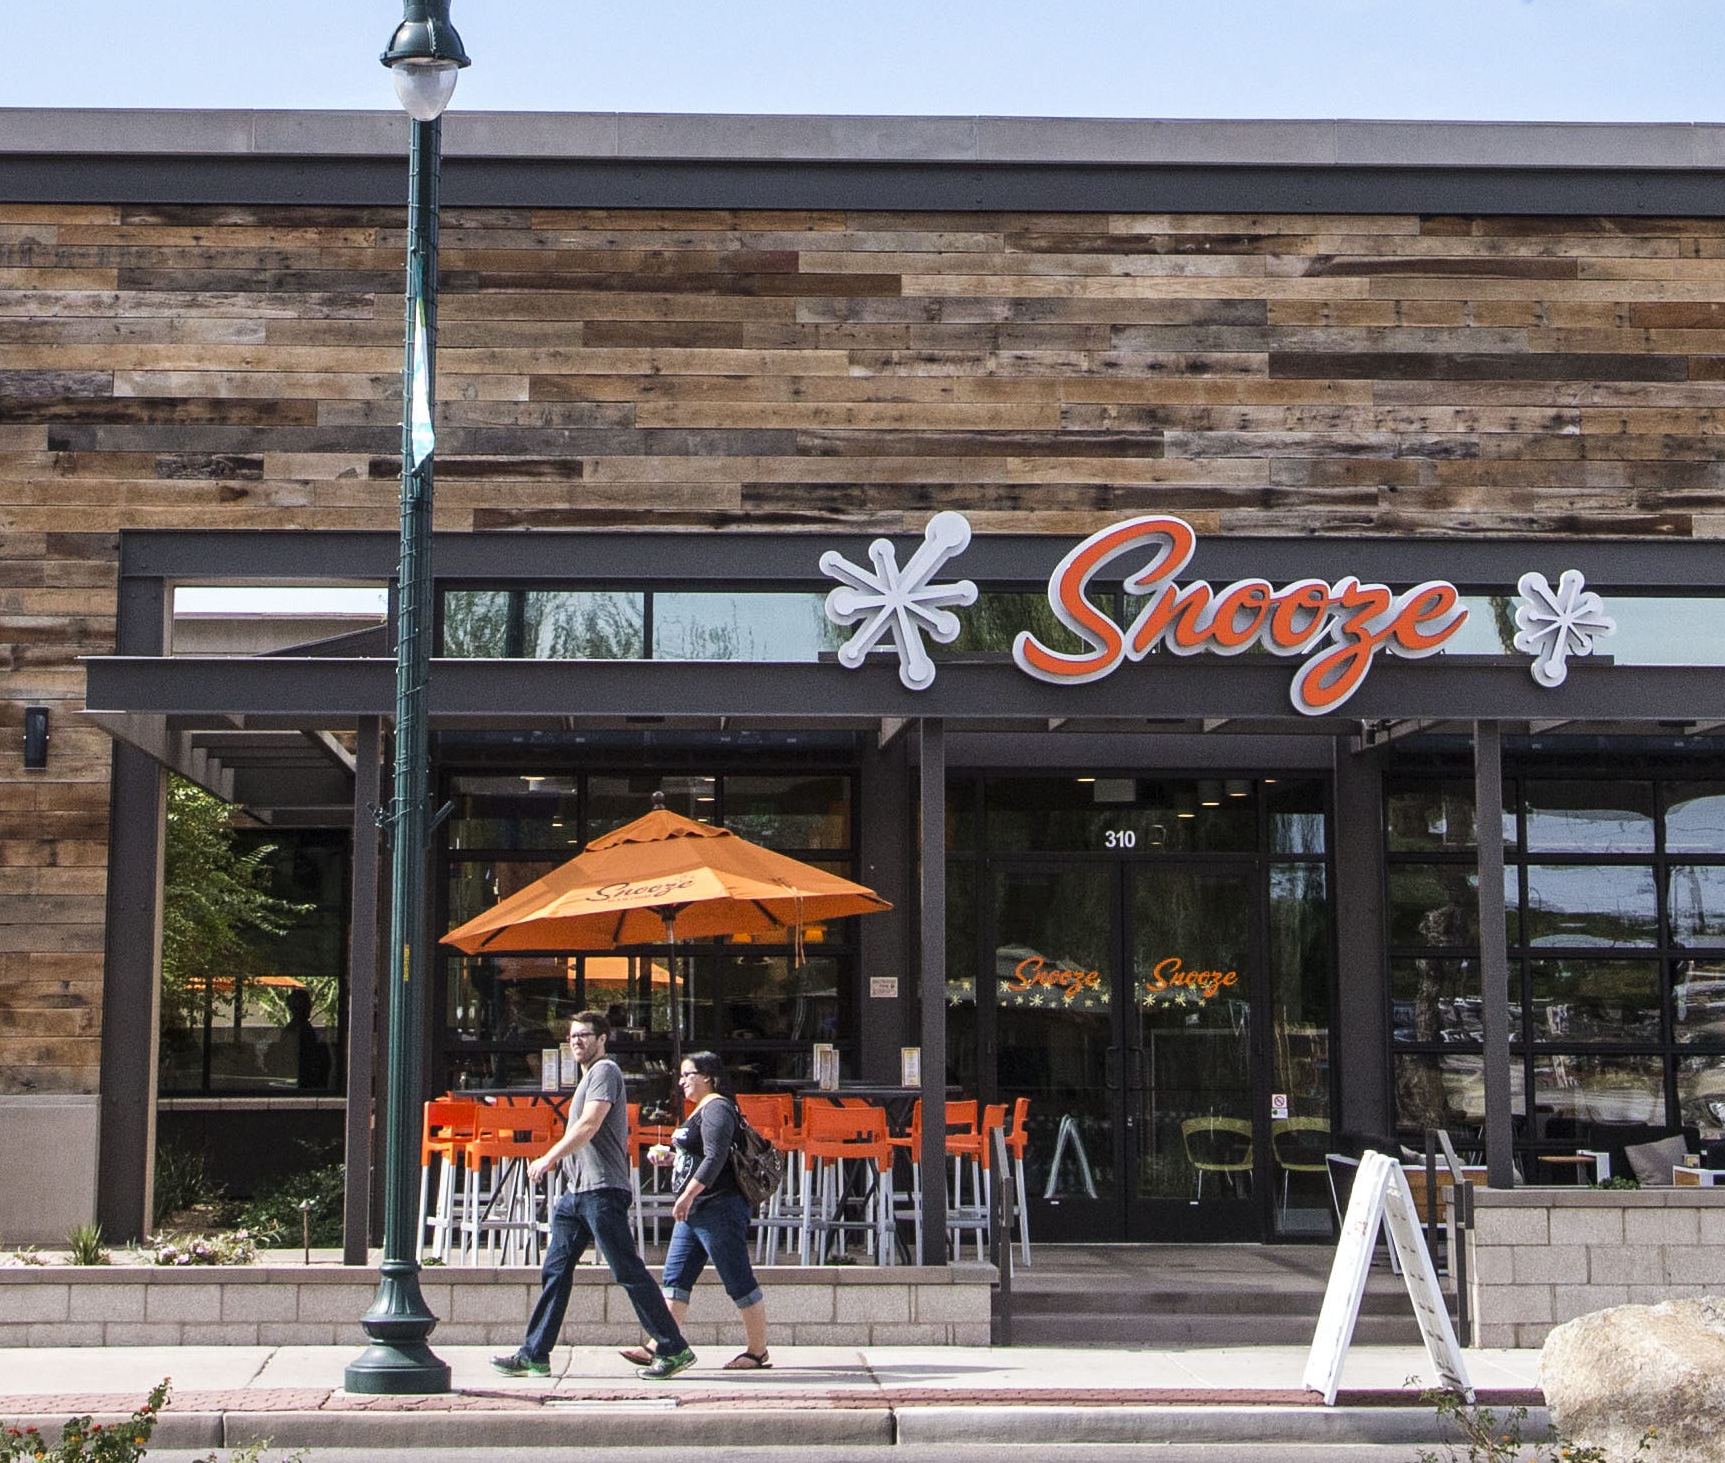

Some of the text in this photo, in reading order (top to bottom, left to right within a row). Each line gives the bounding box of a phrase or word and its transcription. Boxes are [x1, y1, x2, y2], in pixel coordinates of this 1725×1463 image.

[1014, 516, 1468, 715] Snooze
[1105, 830, 1136, 848] 310
[585, 881, 693, 901] Snooze
[1008, 956, 1100, 997] Snooze
[1146, 957, 1238, 998] Snooze
